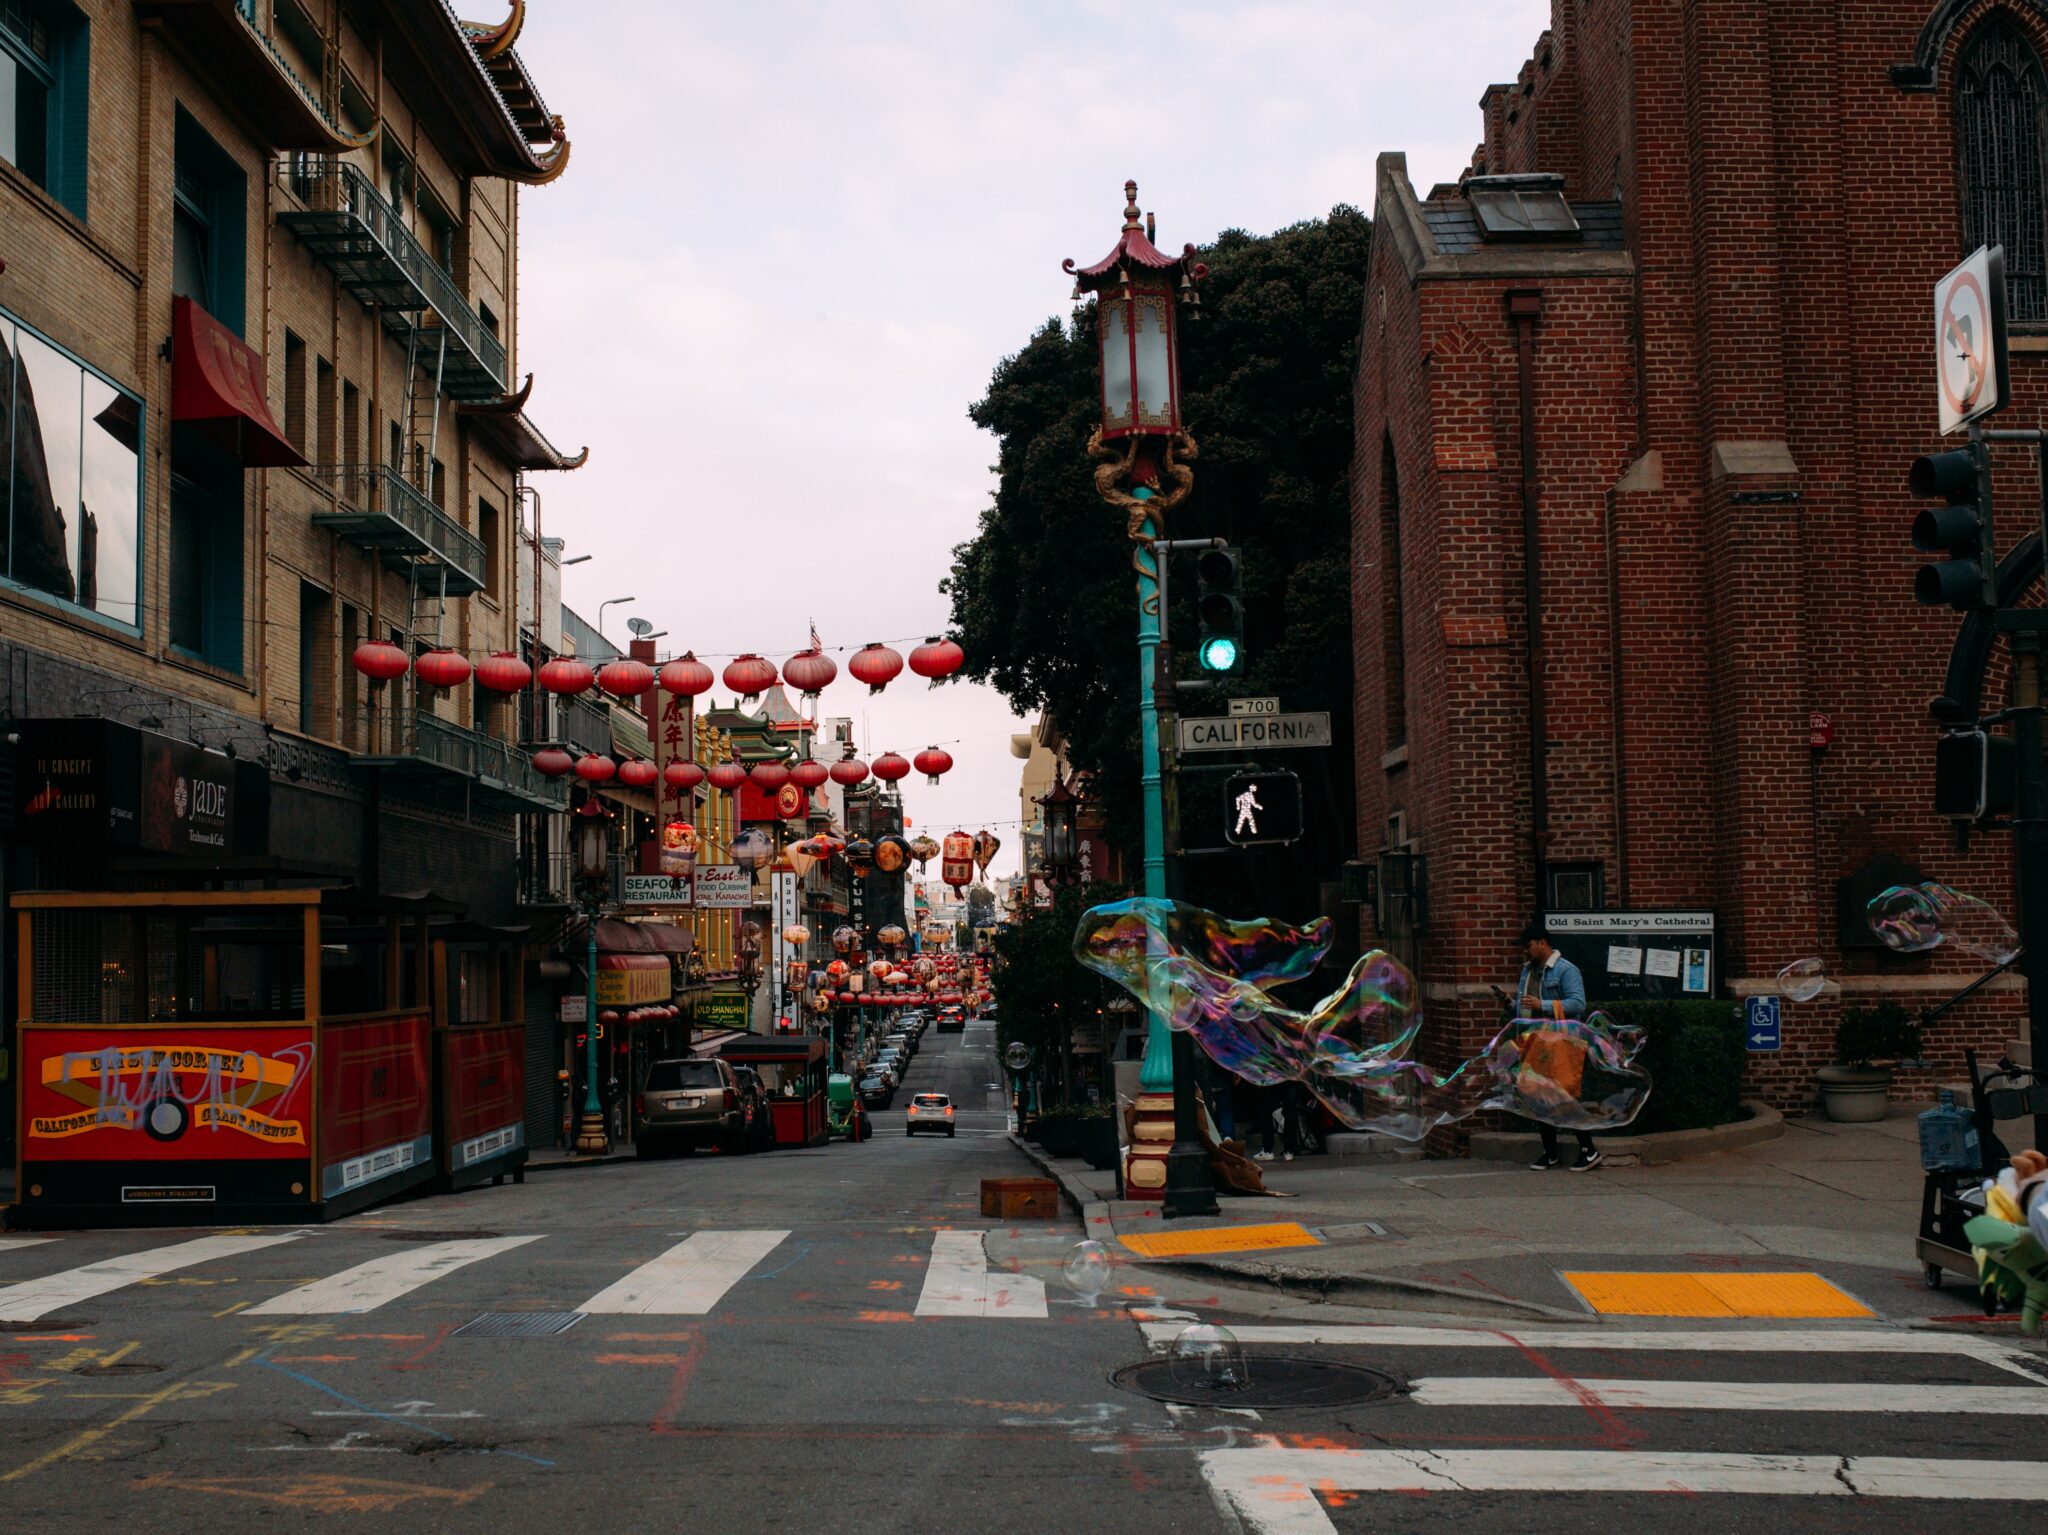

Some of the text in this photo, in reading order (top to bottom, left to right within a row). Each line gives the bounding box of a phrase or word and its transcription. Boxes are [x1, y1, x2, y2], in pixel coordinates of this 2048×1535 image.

[1246, 701, 1274, 712] 700
[1192, 721, 1318, 743] CALIFORNIA
[704, 868, 734, 882] East
[625, 891, 688, 901] RESTAURANT
[1549, 917, 1711, 927] Old Saint Mary's Cathedral
[697, 1005, 745, 1015] OLD SHANGHAI
